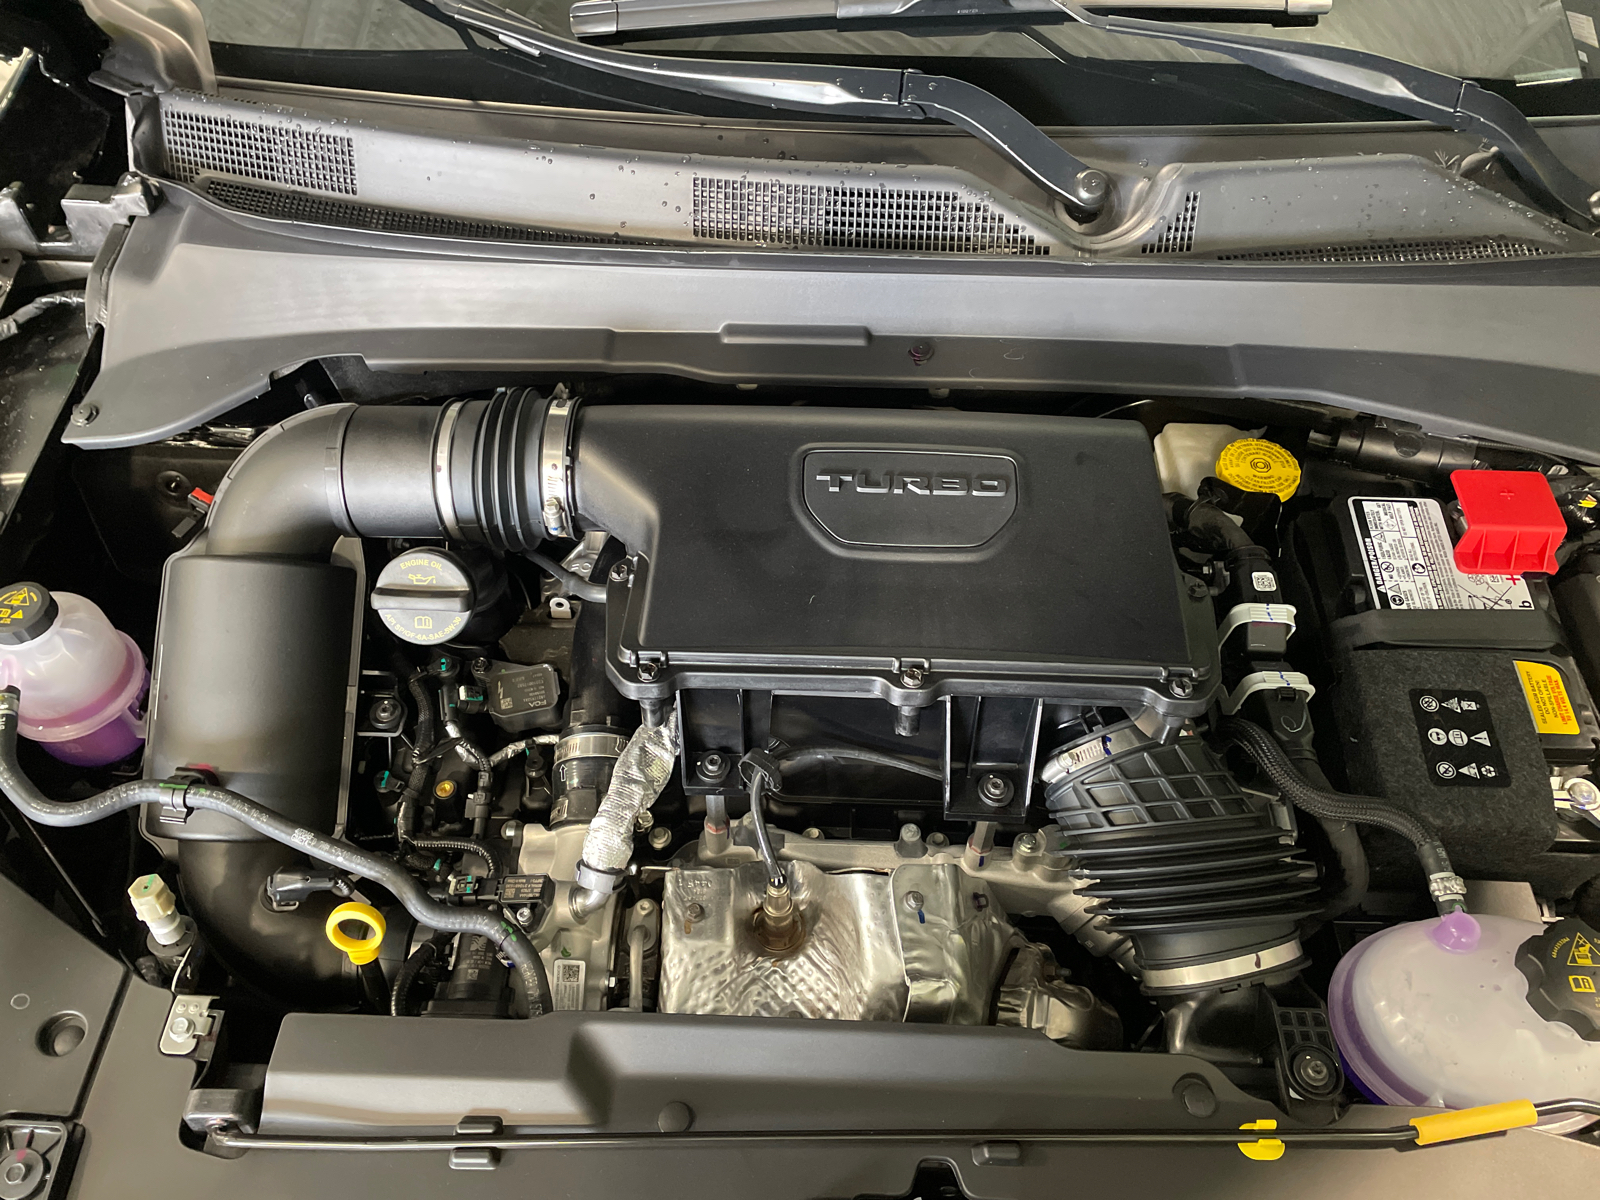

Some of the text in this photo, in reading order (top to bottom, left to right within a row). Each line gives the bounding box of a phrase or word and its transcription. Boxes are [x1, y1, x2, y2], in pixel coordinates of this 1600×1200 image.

[816, 472, 1006, 497] TURBO
[400, 559, 443, 571] ENGINE OIL
[384, 613, 398, 626] API
[1526, 671, 1536, 692] BATTERY
[1542, 680, 1558, 718] NON-SPILLABLE
[1537, 705, 1547, 724] SEALED
[1544, 707, 1550, 715] DO
